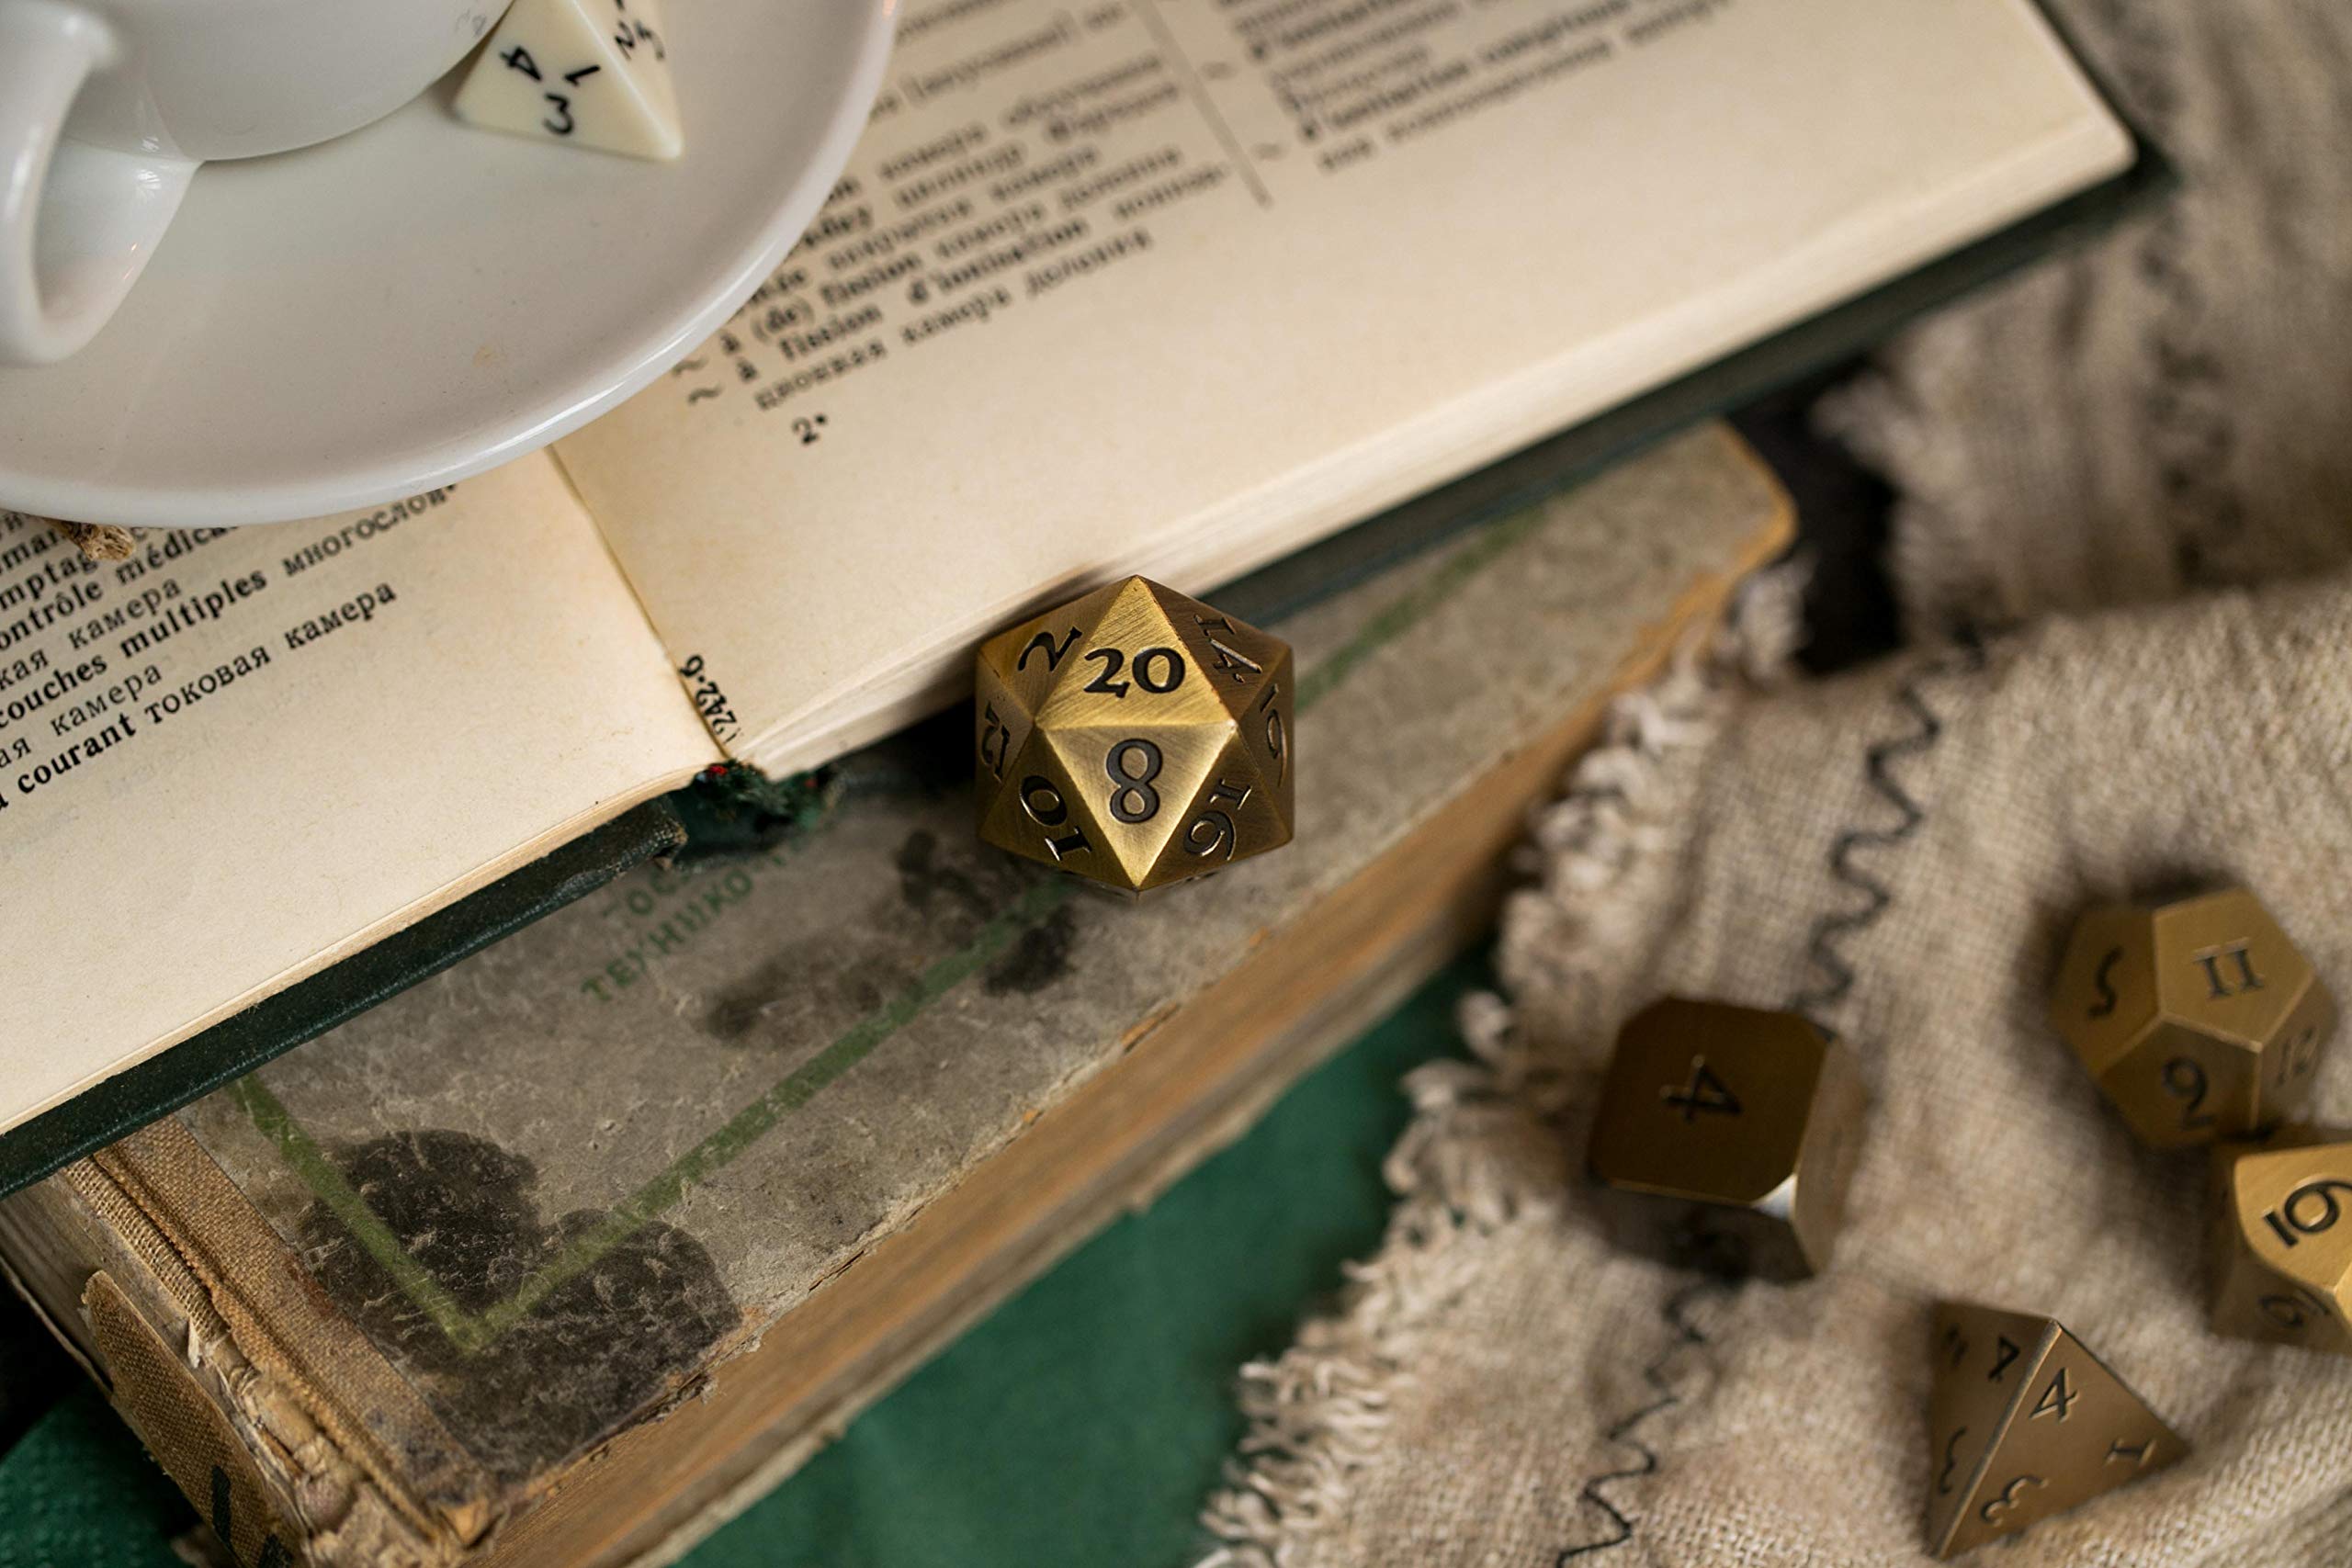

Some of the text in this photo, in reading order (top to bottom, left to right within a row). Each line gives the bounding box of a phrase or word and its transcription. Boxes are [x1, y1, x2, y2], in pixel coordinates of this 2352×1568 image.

[500, 46, 542, 81] 4
[544, 94, 574, 135] 3
[69, 577, 182, 650] камера
[119, 569, 267, 660] multiples
[1017, 626, 1082, 672] 2
[1083, 647, 1186, 699] 20
[1193, 615, 1262, 683] 14
[17, 580, 397, 794] courant токовая камера
[51, 664, 163, 737] камера
[1105, 738, 1163, 824] 8
[1019, 775, 1092, 862] 10
[1183, 778, 1252, 861] 16
[1659, 1056, 1742, 1124] 4
[1988, 1336, 2020, 1382] 4
[2030, 1368, 2078, 1423] 4
[1980, 1473, 2049, 1528] 3
